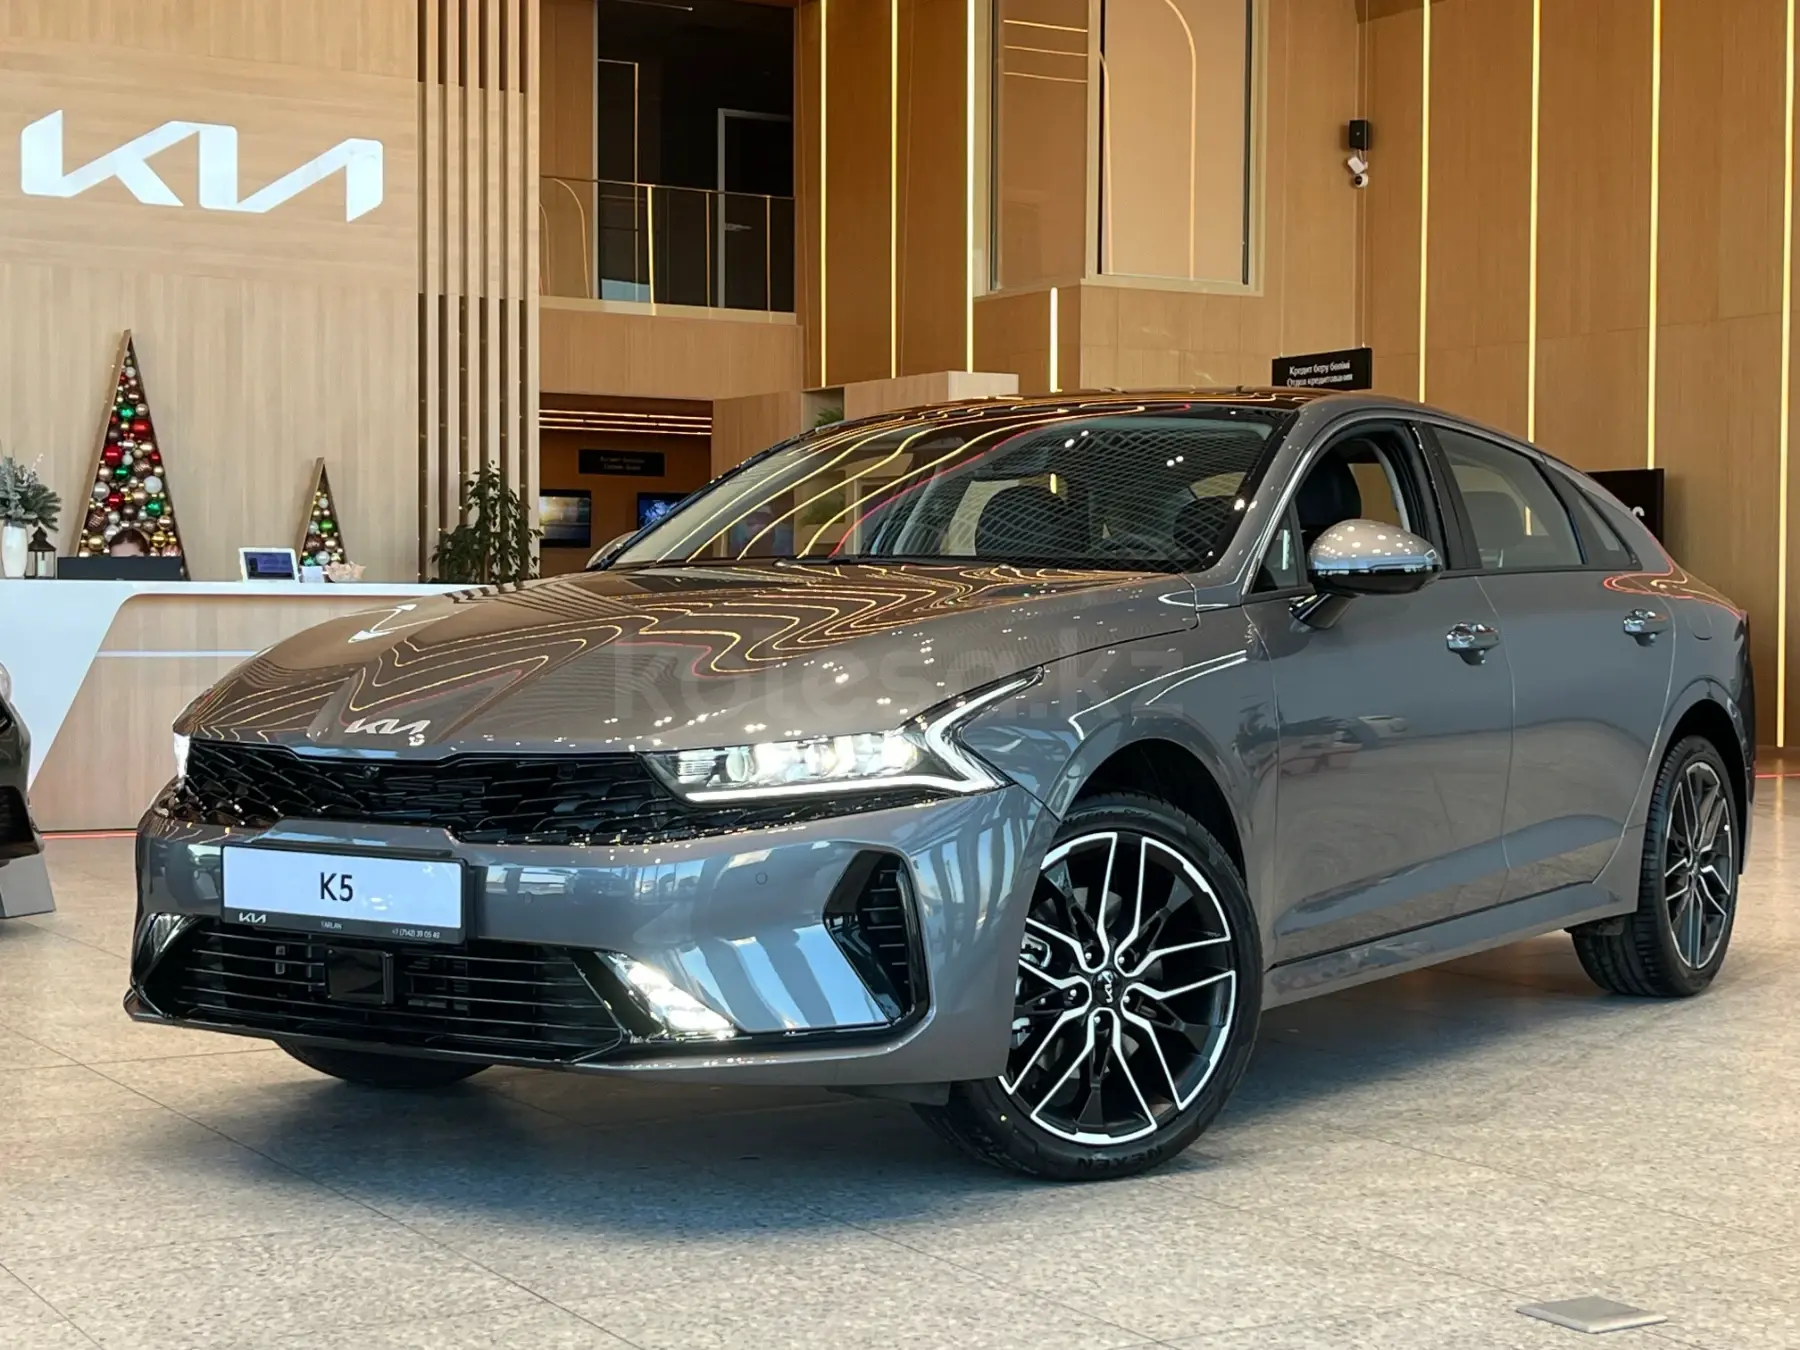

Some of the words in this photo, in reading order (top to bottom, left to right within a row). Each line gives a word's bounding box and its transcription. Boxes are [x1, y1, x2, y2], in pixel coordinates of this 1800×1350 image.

[21, 110, 383, 222] KIA
[1289, 365, 1312, 377] Кредит
[344, 718, 431, 735] KIA
[319, 871, 354, 902] K5
[239, 912, 266, 923] KIA
